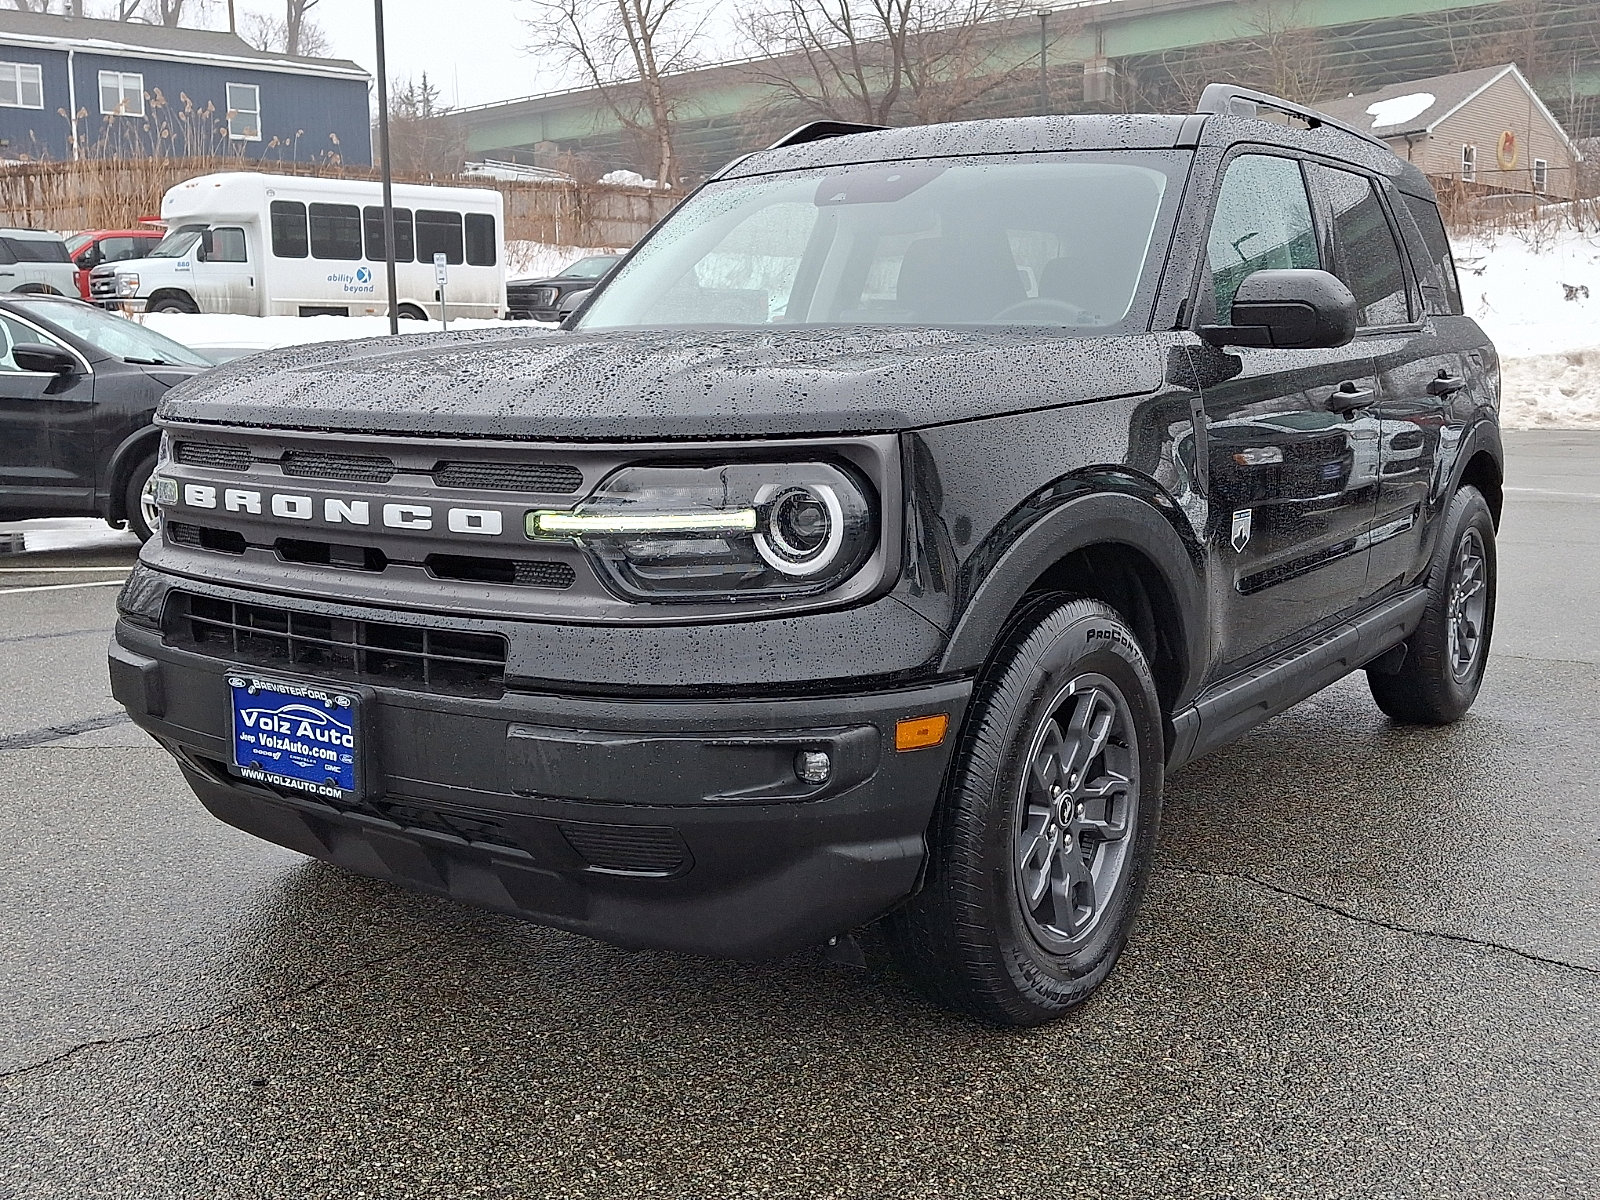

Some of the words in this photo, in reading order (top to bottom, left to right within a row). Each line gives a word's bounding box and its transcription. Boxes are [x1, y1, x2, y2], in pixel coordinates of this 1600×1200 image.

[327, 273, 354, 284] ability
[343, 284, 374, 293] beyond
[184, 483, 503, 535] BRONCO
[240, 709, 291, 734] Volz
[296, 722, 354, 748] Auto
[239, 731, 256, 744] Jeep
[258, 733, 338, 762] VolzAuto.com
[324, 764, 342, 773] GMC
